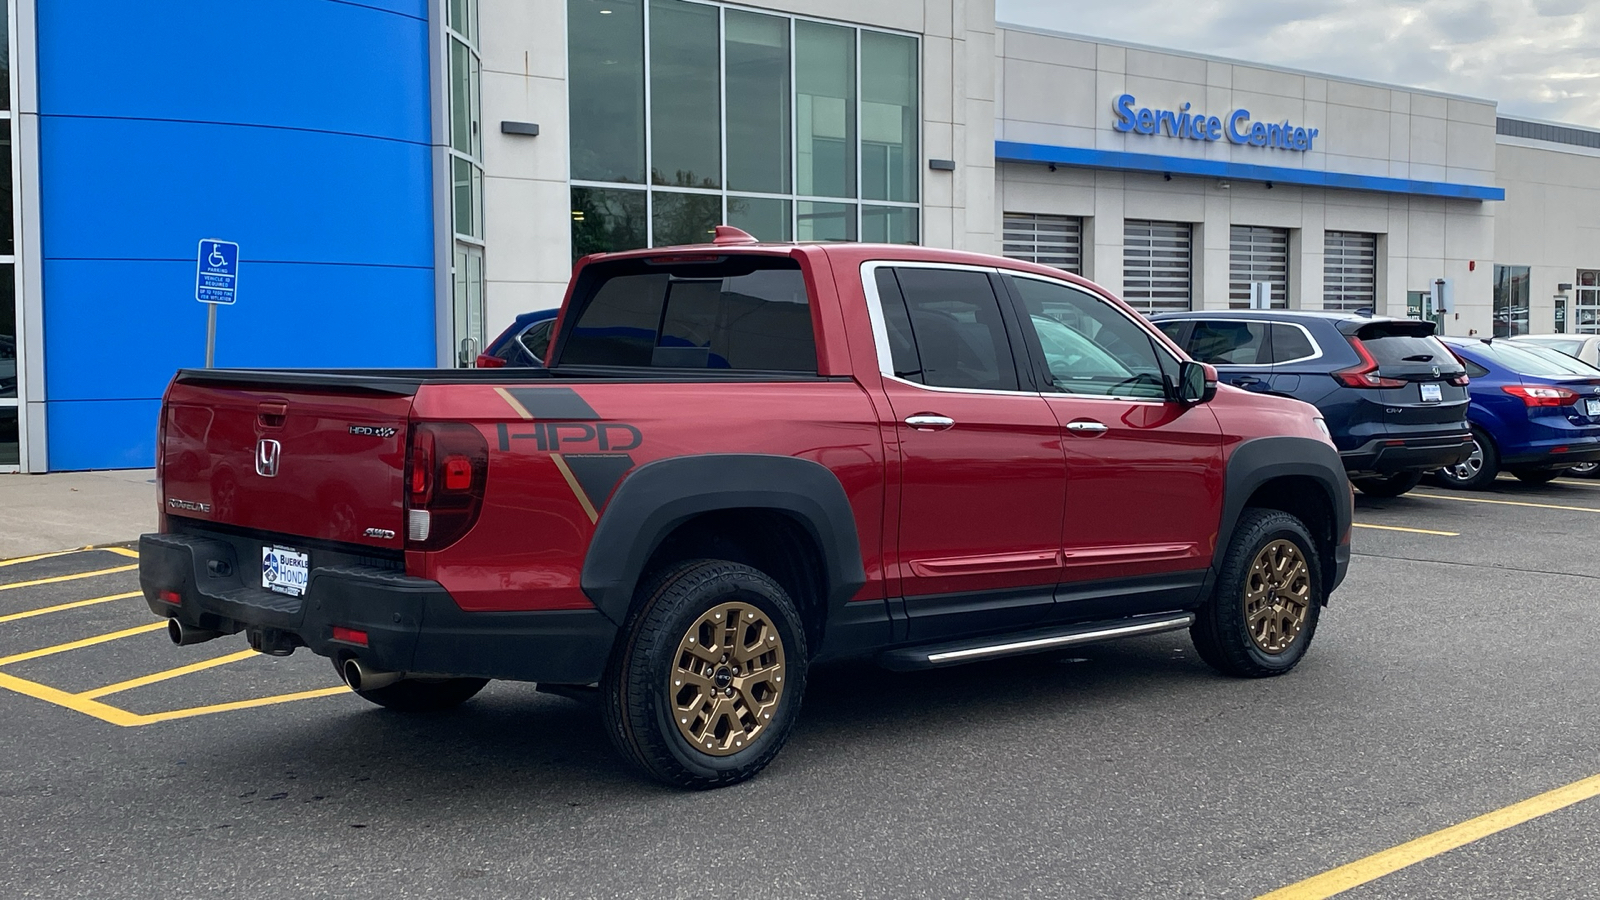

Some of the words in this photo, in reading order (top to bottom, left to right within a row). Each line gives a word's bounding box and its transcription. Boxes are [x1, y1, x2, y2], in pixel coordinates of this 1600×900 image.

[1112, 94, 1222, 142] Service
[1225, 109, 1319, 151] Center
[349, 426, 373, 436] HPD
[497, 423, 643, 452] HPD
[280, 566, 308, 584] HONDA
